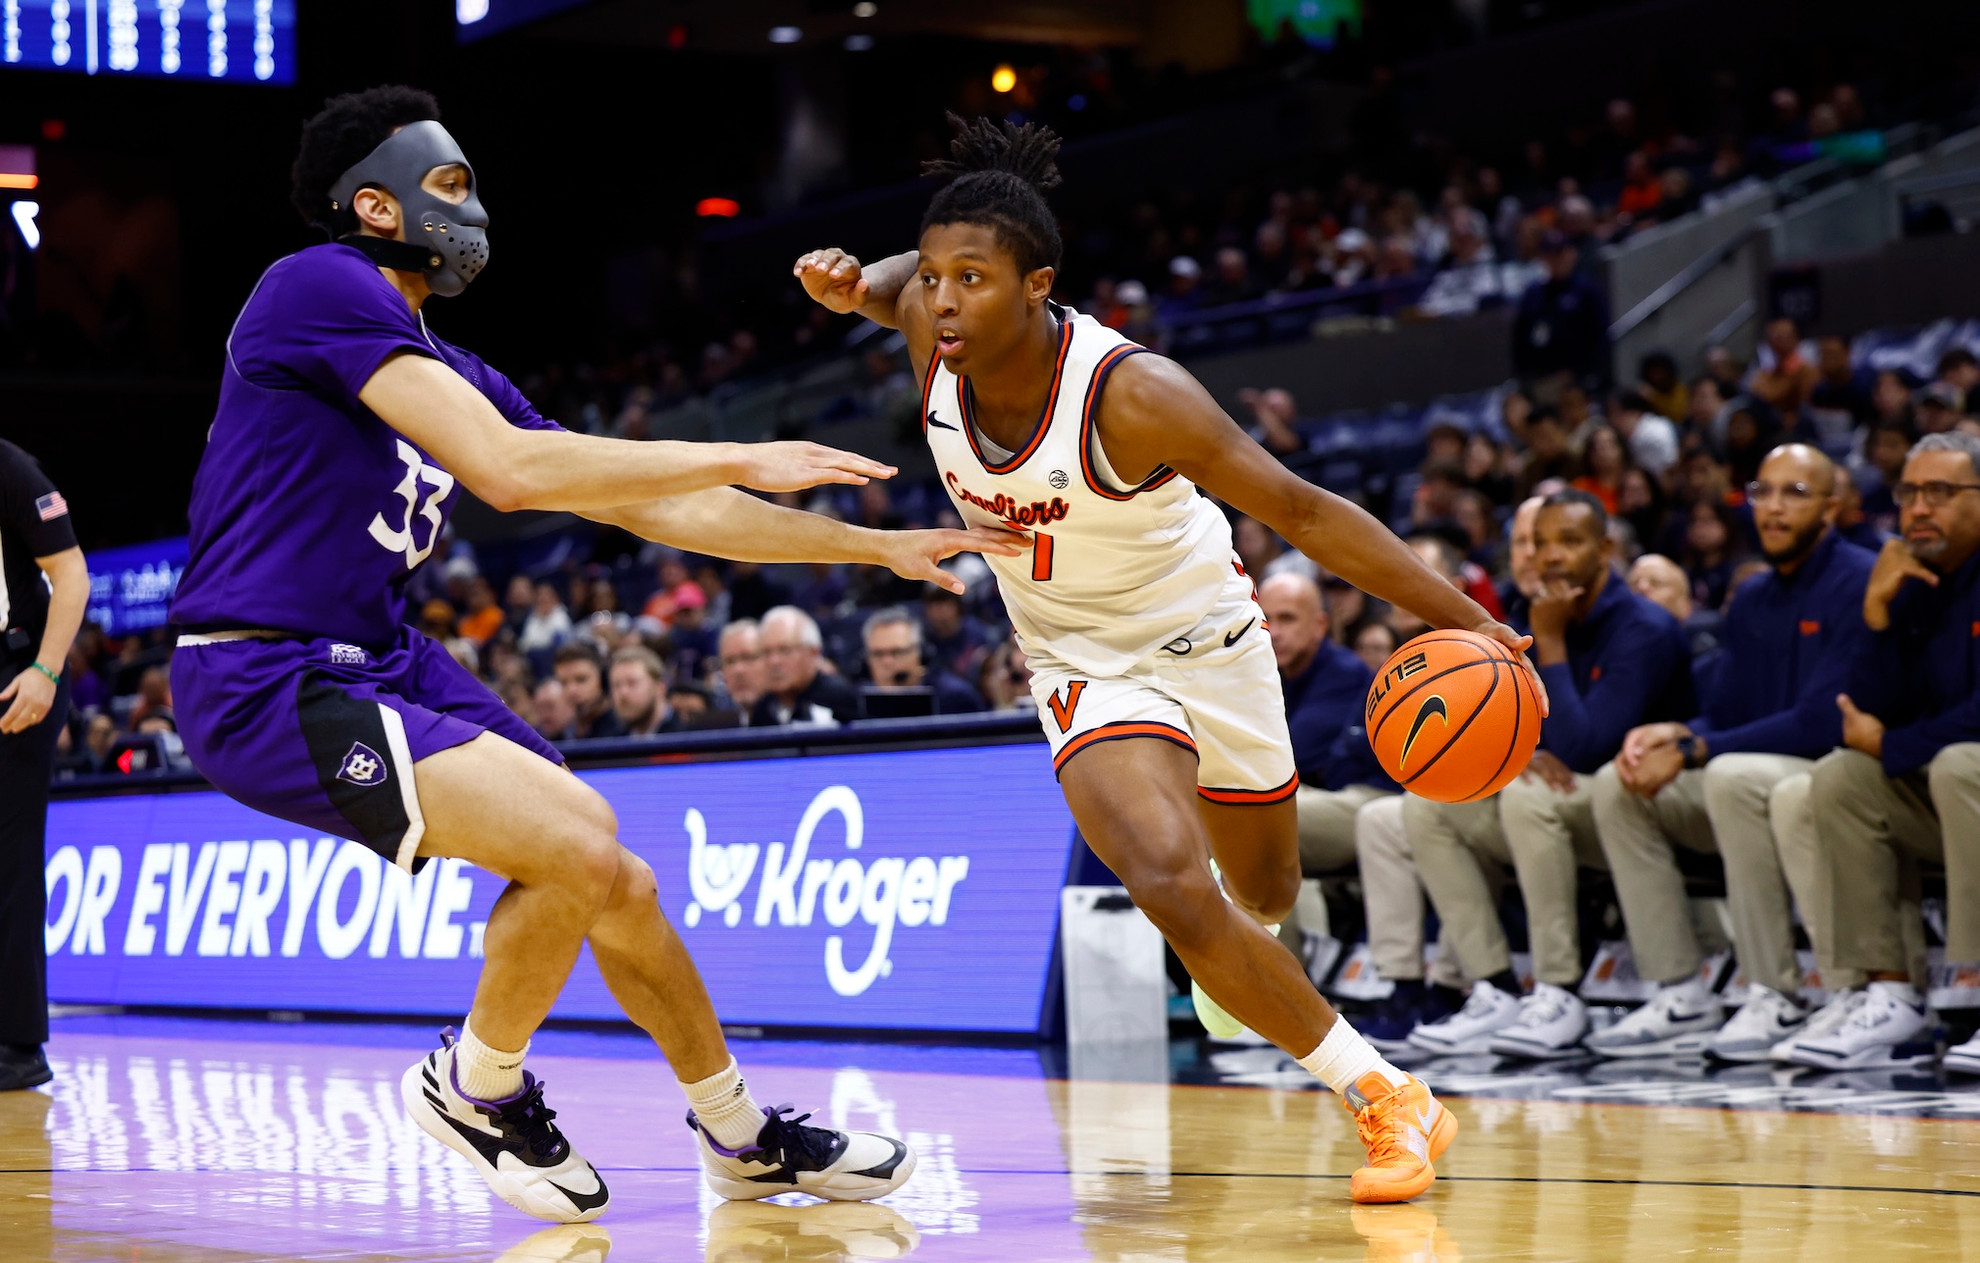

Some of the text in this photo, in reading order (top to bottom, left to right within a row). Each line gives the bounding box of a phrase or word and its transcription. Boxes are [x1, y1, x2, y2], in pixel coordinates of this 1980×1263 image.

[367, 438, 455, 570] 33
[1047, 680, 1088, 735] V
[1367, 652, 1428, 722] ELITE
[753, 785, 970, 997] Kroger
